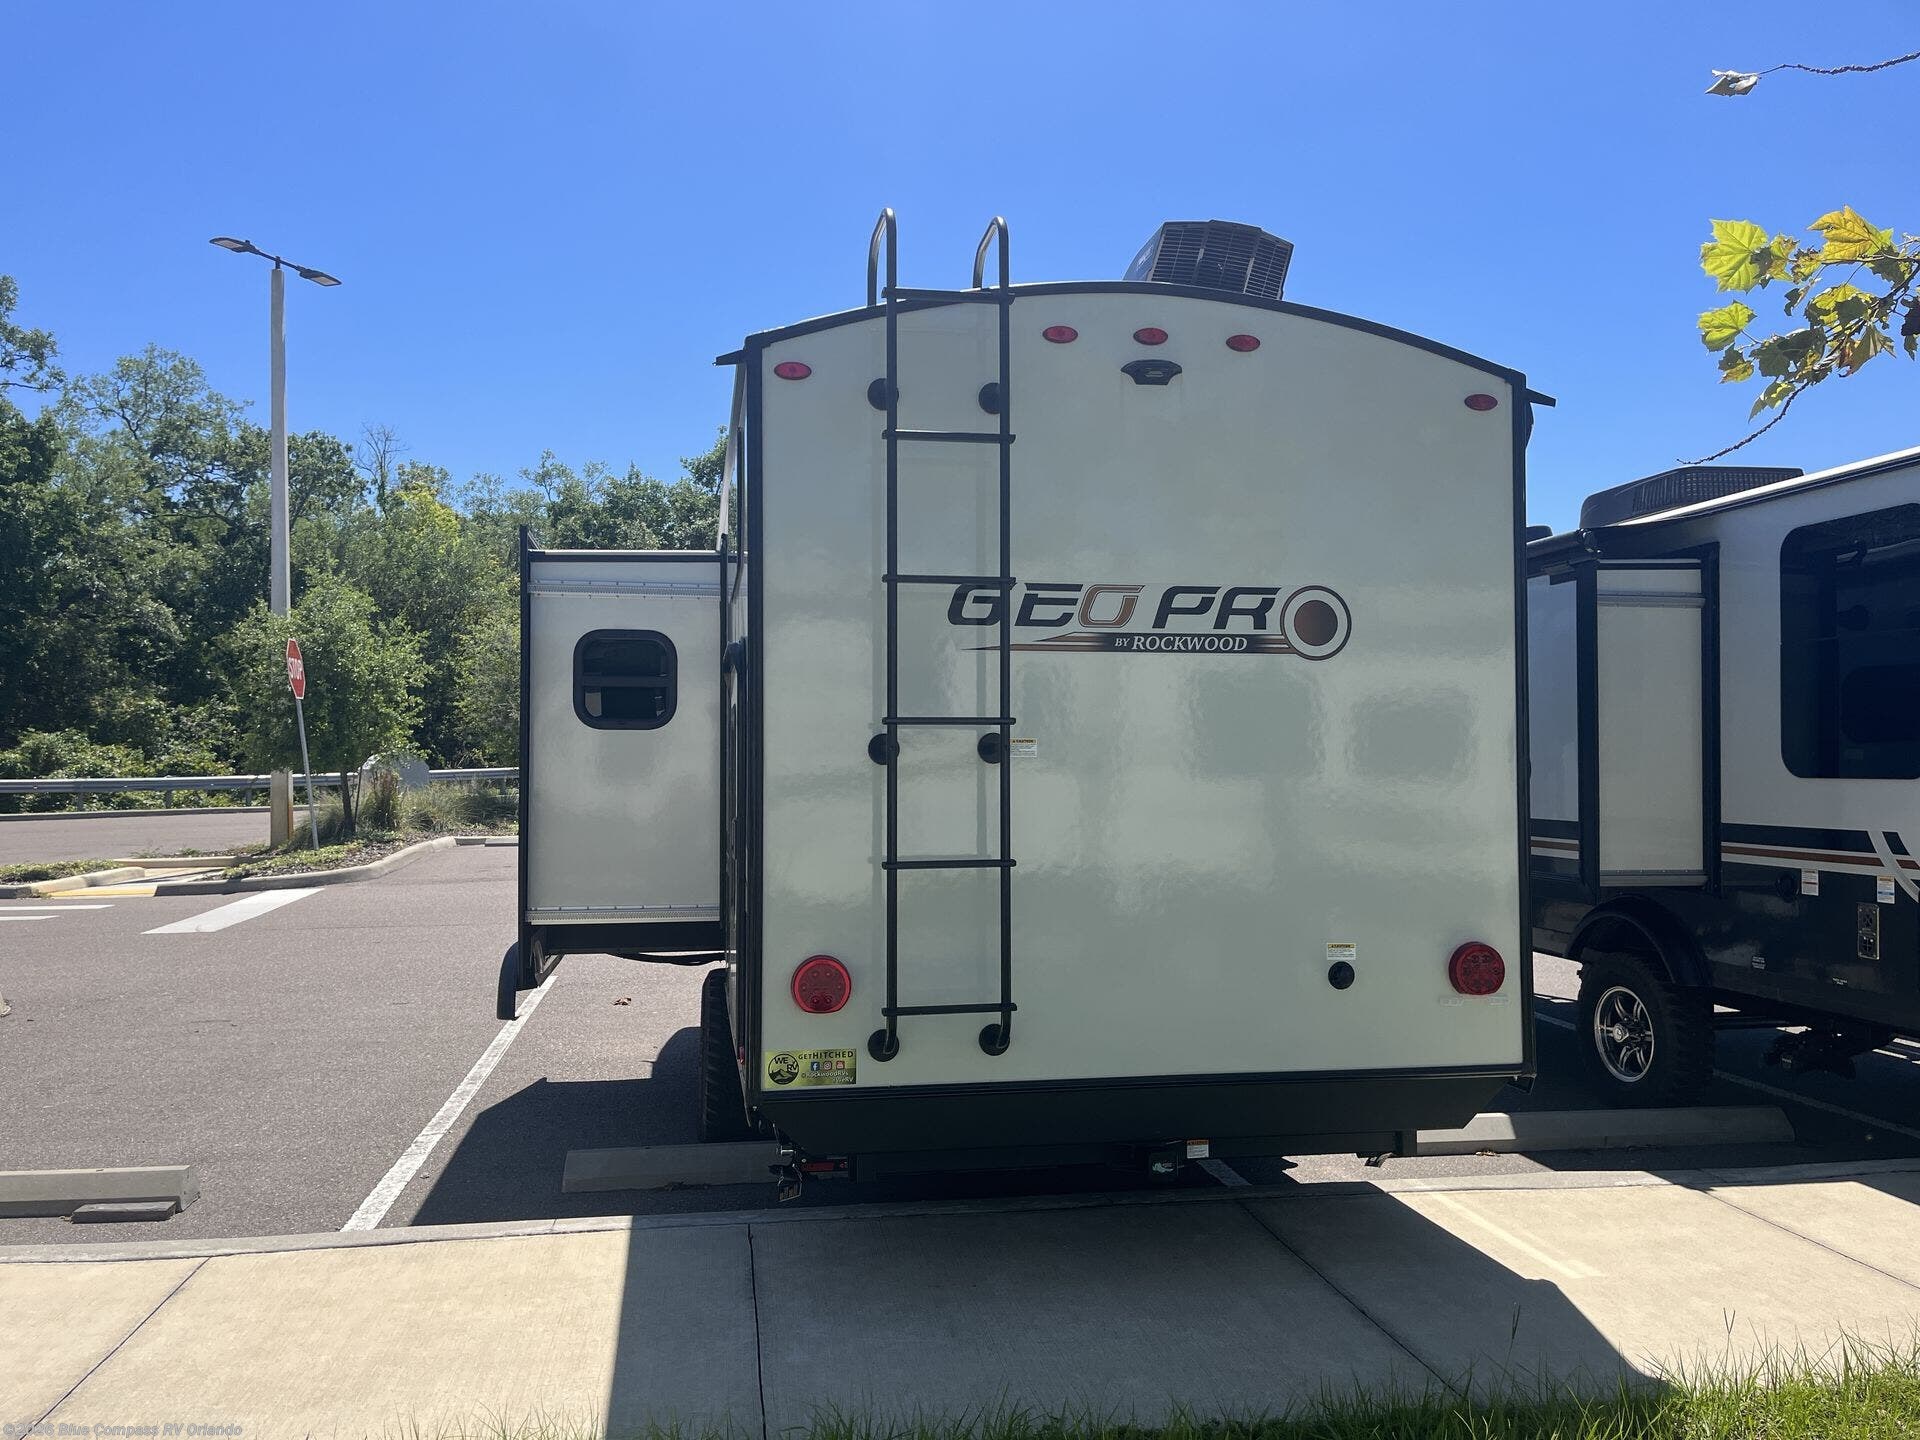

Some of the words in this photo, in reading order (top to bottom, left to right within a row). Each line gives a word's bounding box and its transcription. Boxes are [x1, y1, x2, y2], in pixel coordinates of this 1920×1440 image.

[947, 583, 1146, 628] GEO
[1114, 638, 1130, 648] BY
[1131, 635, 1248, 652] ROCKWOOD
[288, 657, 303, 680] STOP
[774, 1056, 789, 1064] WE
[786, 1061, 799, 1072] RV
